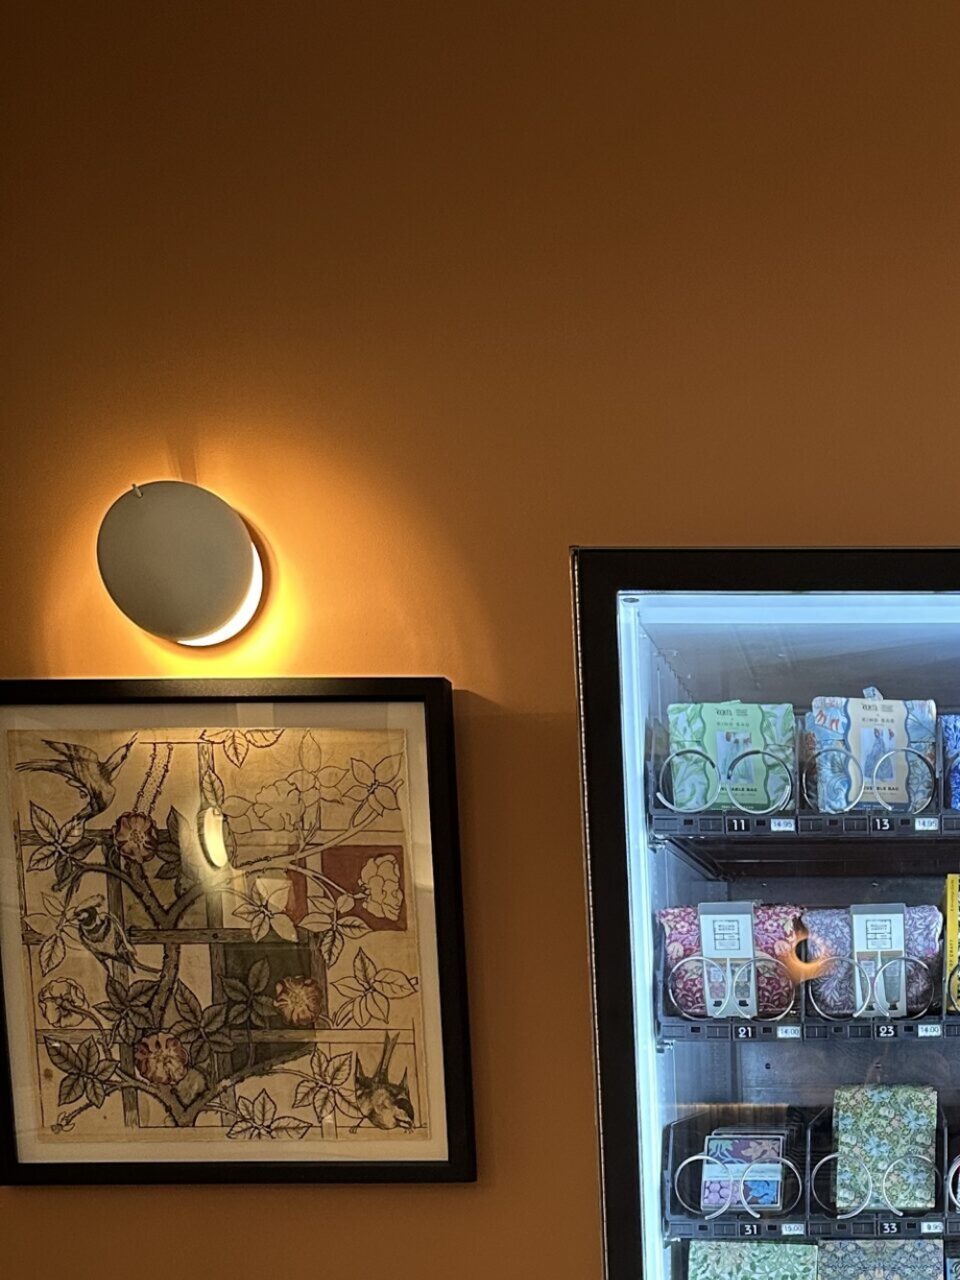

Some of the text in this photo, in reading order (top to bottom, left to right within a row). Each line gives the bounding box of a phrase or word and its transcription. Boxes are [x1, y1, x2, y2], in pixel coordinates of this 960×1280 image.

[732, 819, 745, 831] 11
[875, 818, 890, 830] 13
[738, 1026, 752, 1038] 21
[880, 1026, 894, 1037] 23
[744, 1224, 758, 1235] 31
[882, 1222, 898, 1233] 33
